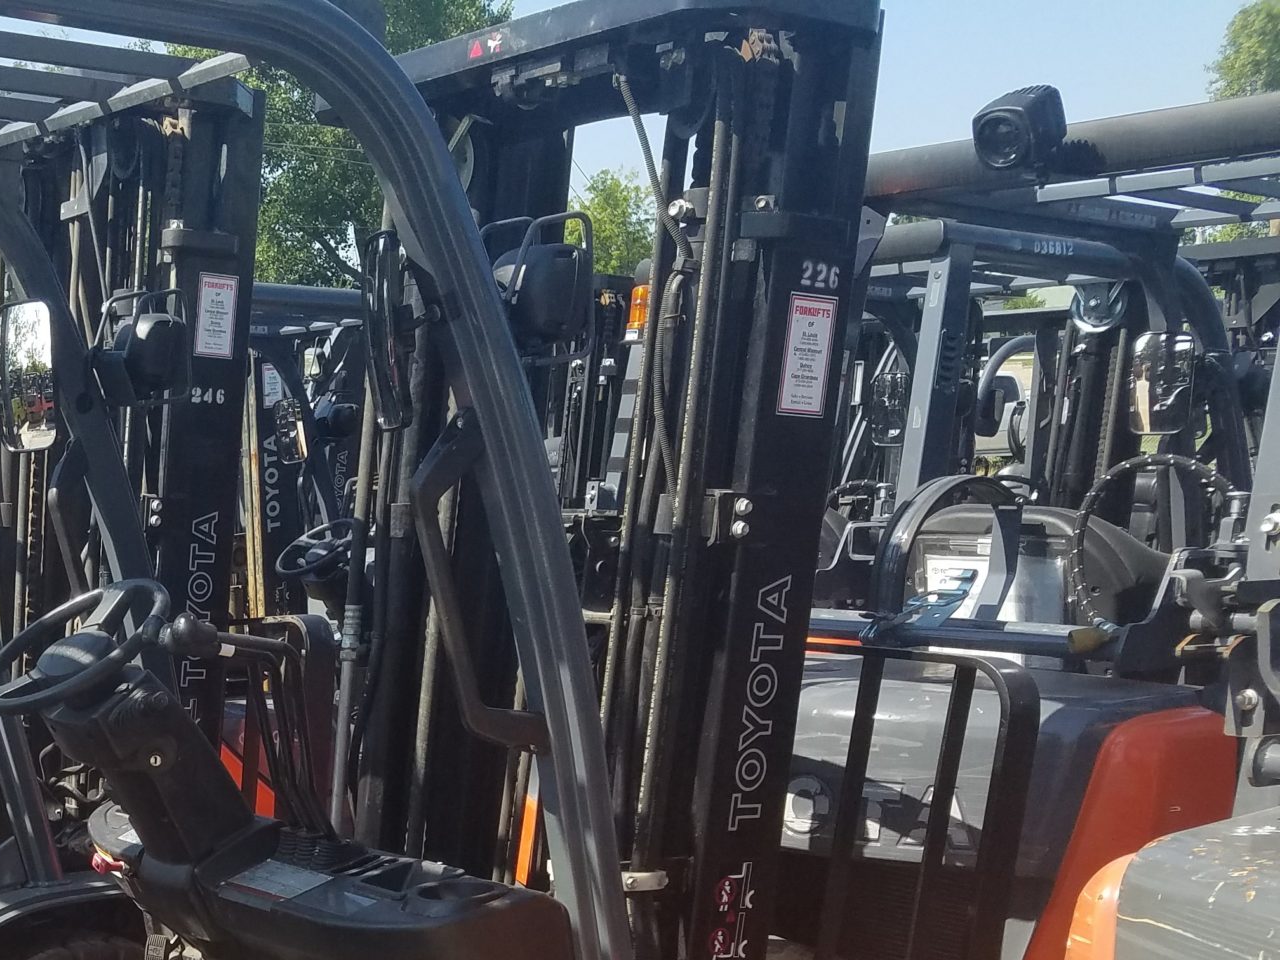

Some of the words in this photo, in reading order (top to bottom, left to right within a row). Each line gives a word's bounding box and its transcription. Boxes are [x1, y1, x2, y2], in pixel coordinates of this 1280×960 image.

[800, 260, 840, 289] 226
[794, 305, 831, 319] FORKLIFTS
[191, 387, 225, 404] 246
[263, 434, 281, 533] TOYOTA
[180, 511, 219, 687] TYOTA
[728, 574, 792, 832] TOYOTA
